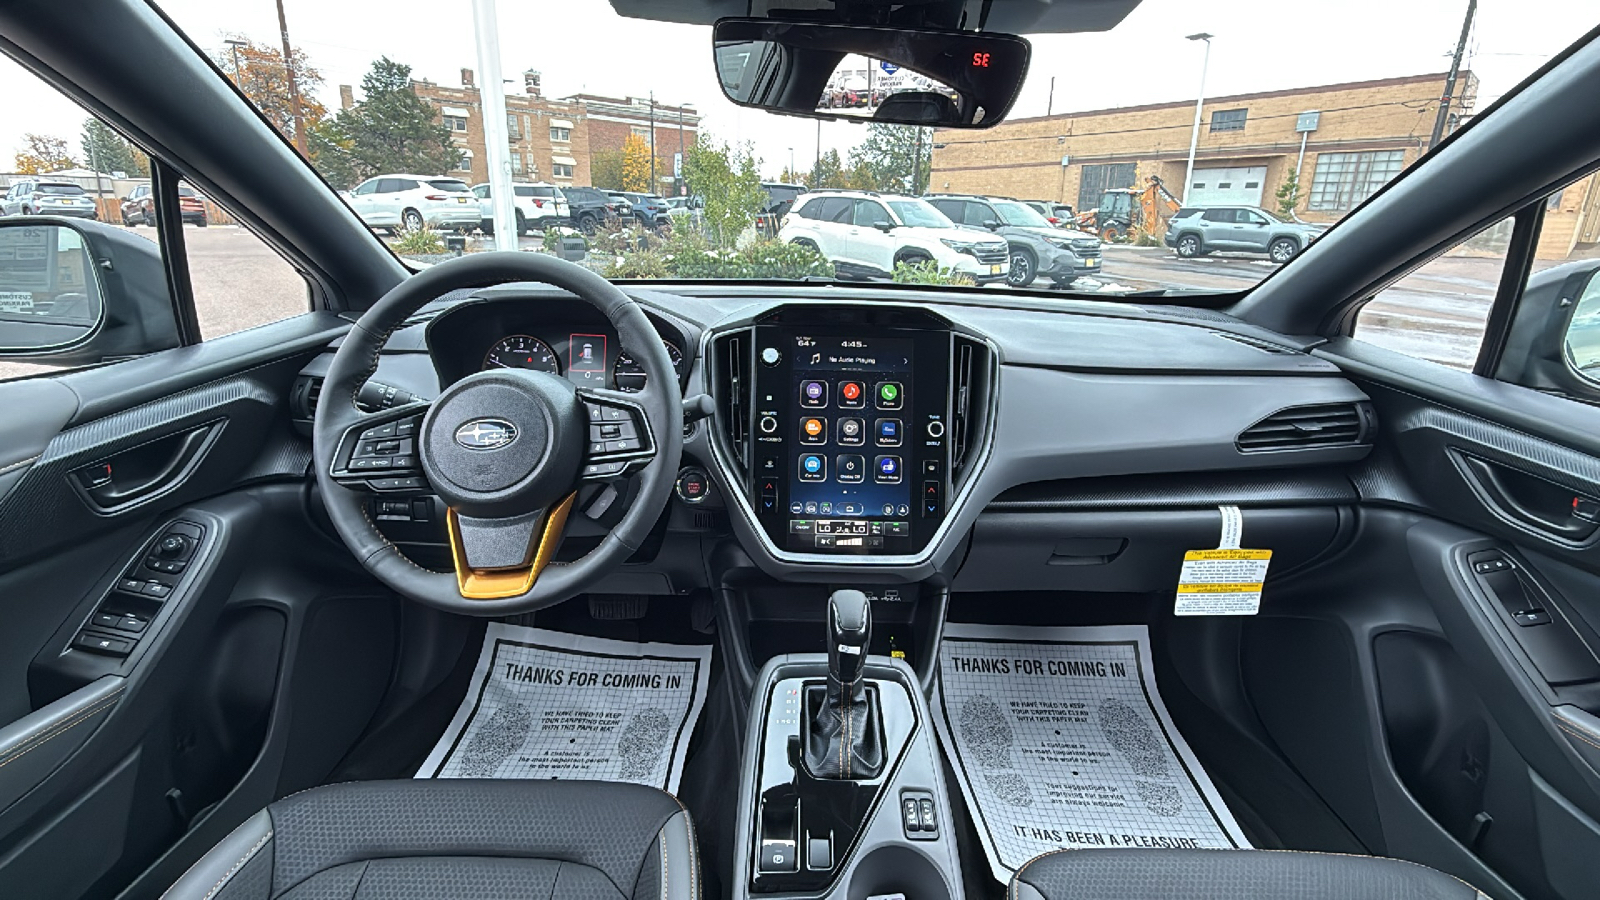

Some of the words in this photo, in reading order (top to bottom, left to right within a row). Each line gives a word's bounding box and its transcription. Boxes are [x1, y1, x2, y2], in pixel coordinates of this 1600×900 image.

[973, 53, 990, 67] SE
[506, 663, 564, 686] THANKS
[568, 672, 598, 686] FOR
[602, 674, 661, 688] COMING
[666, 675, 680, 688] IN
[952, 657, 1010, 674] THANKS
[1015, 659, 1044, 675] FOR
[1048, 660, 1107, 677] COMING
[1110, 662, 1126, 677] IN
[1013, 824, 1027, 837] IT
[1031, 828, 1062, 842] HAS
[1066, 831, 1105, 846] BEEN
[1110, 834, 1120, 846] A
